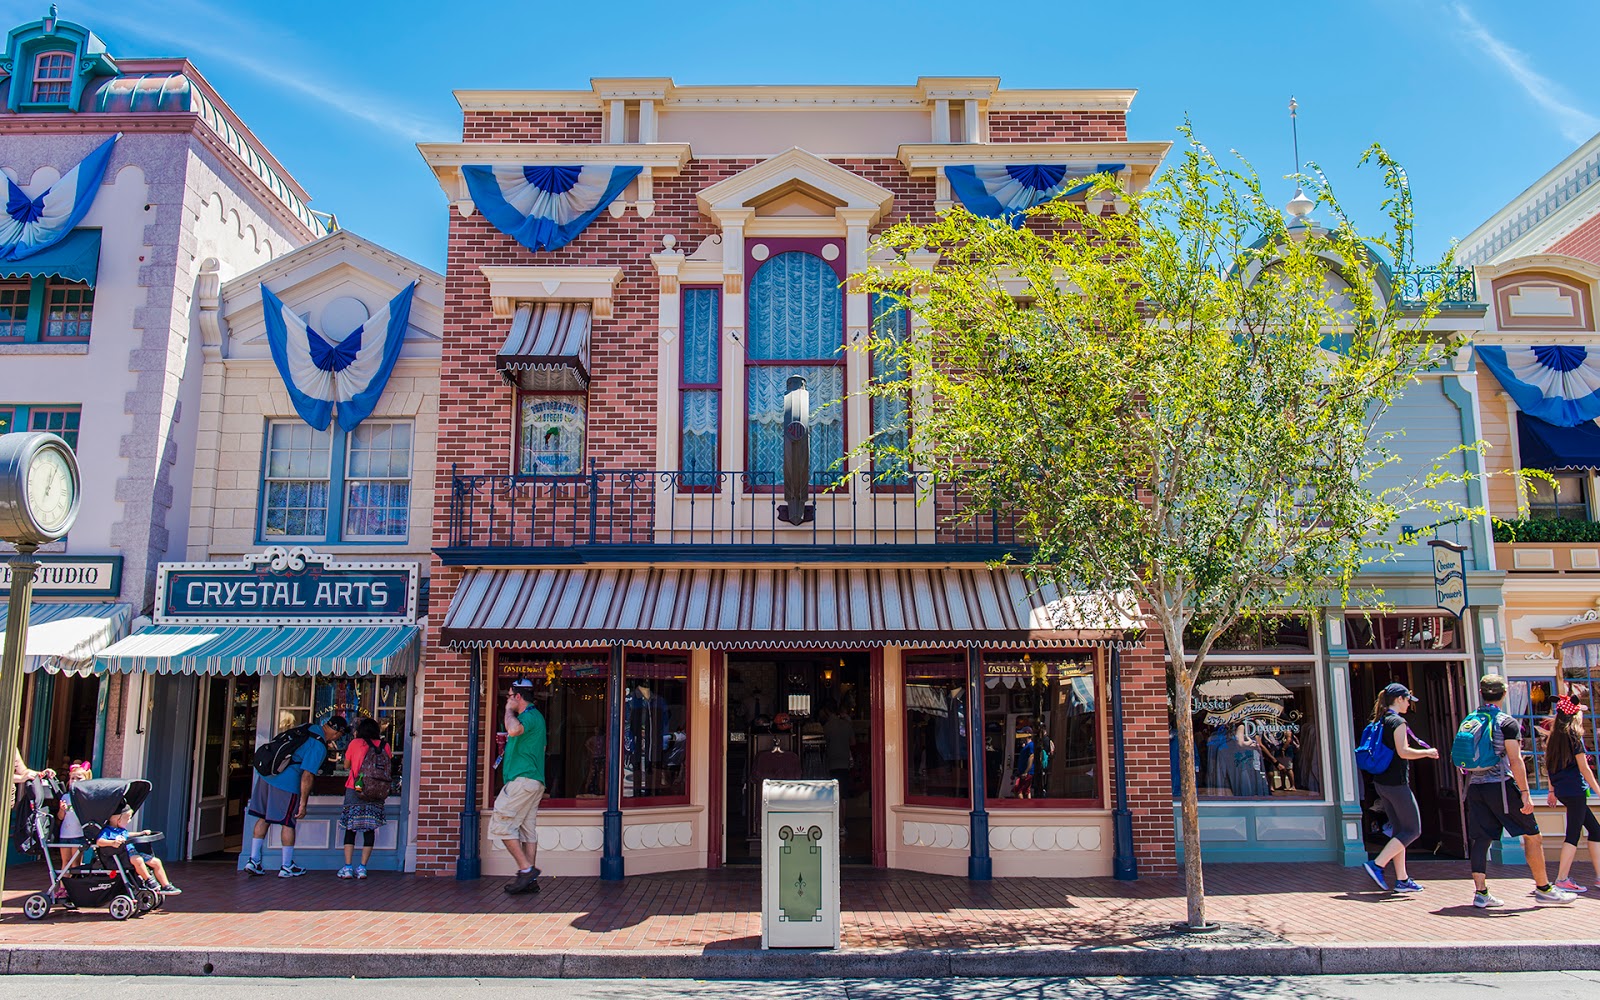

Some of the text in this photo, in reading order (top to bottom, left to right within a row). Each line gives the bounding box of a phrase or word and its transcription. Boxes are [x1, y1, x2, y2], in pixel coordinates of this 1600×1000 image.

[1436, 559, 1456, 573] Chester
[186, 581, 389, 606] CRYSTAL ARTS
[1437, 589, 1463, 603] Drawer's
[988, 665, 1011, 673] CASTLE
[315, 703, 372, 718] GLASS CUTTERS
[1191, 695, 1231, 714] Chester
[1243, 718, 1300, 737] Drawer's
